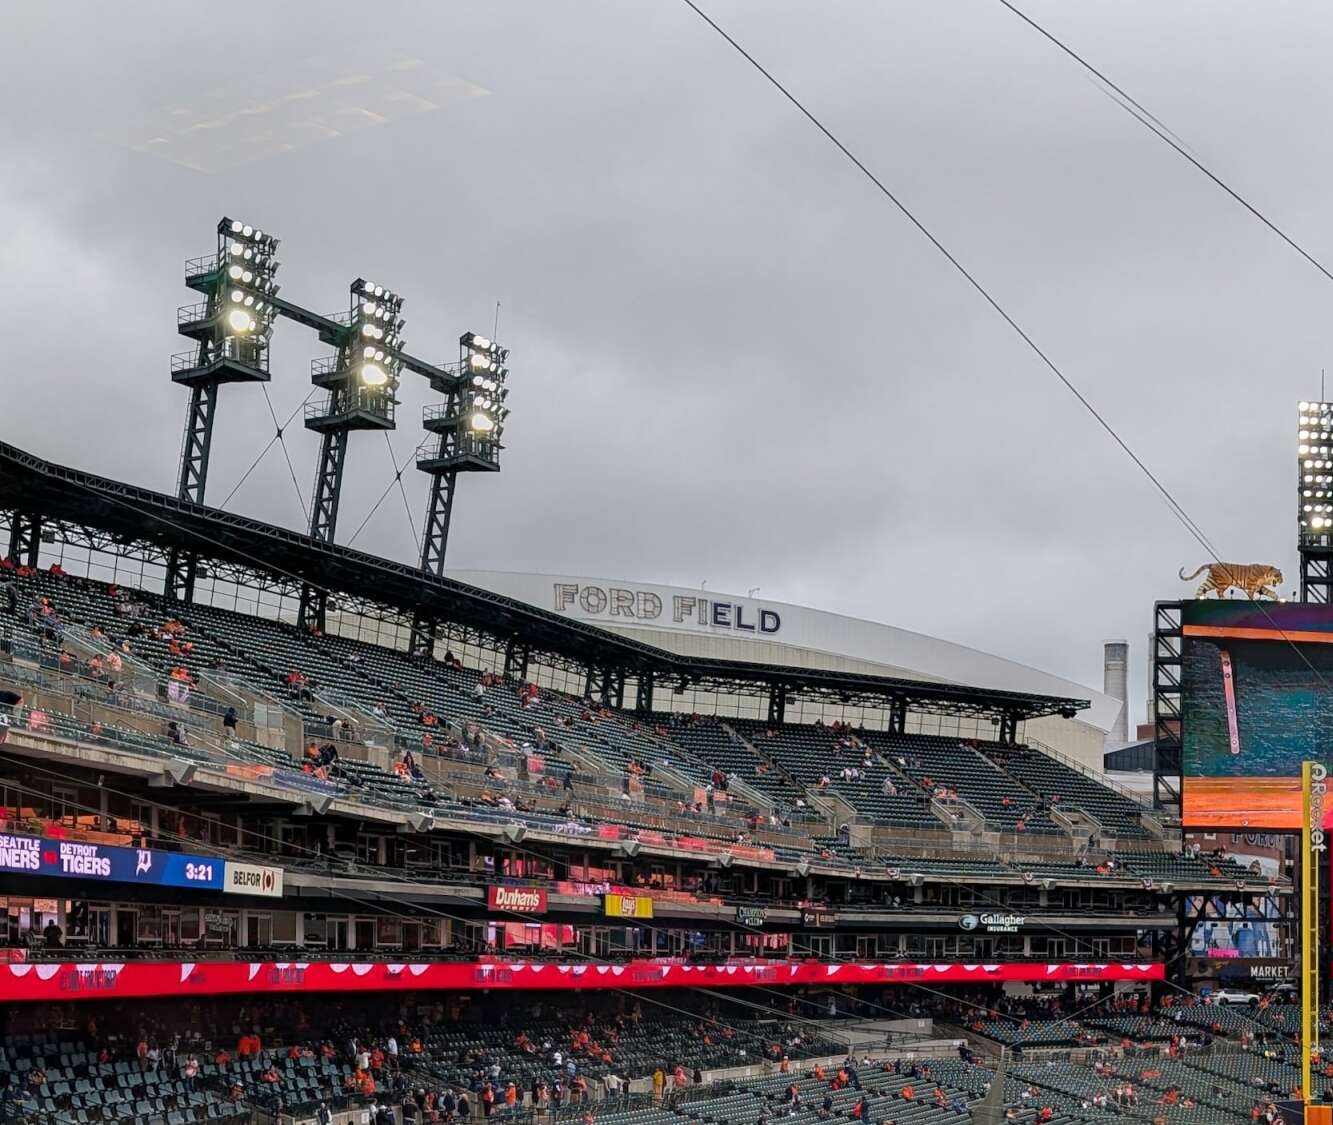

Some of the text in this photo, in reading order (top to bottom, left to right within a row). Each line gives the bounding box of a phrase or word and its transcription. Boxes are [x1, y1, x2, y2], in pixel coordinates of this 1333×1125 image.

[553, 583, 782, 634] FORD FIELD
[60, 842, 98, 857] DETROIT
[60, 854, 111, 876] TIGERS
[186, 863, 213, 881] 3:21
[233, 870, 261, 888] BELFOR
[496, 887, 541, 907] Dunham's
[1250, 965, 1290, 978] MARKET
